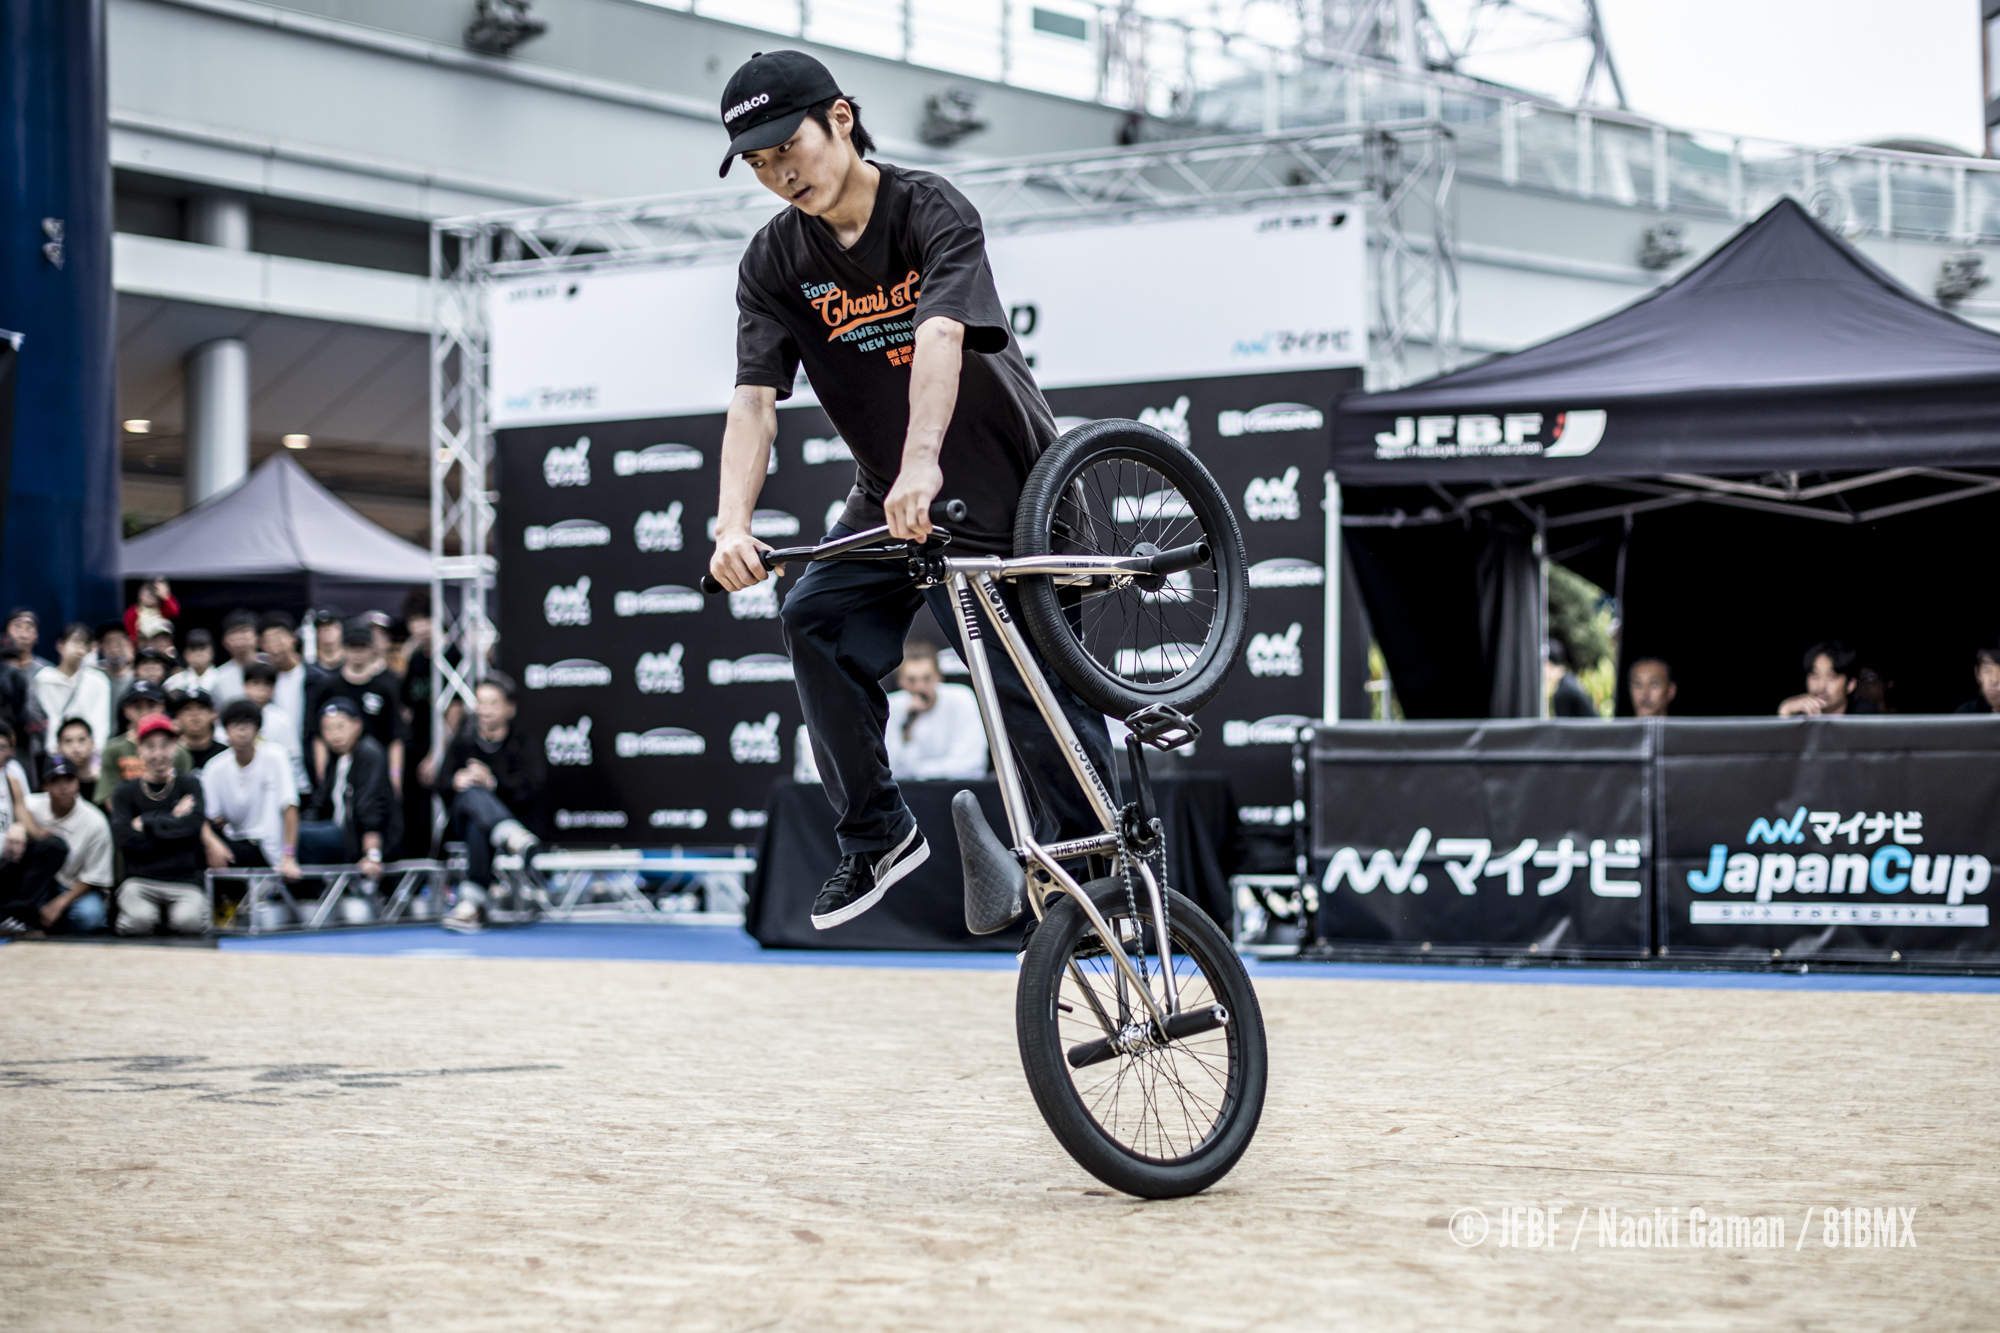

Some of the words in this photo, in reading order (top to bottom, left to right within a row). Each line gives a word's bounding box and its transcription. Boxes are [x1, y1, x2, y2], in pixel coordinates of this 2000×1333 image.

[811, 285, 888, 327] Chari
[840, 325, 883, 342] LOWER
[858, 336, 886, 352] NEW
[1375, 413, 1543, 449] JFBF
[1808, 811, 1924, 845] マイナビ
[1053, 844, 1074, 856] THE
[1075, 838, 1103, 853] PARK
[1436, 838, 1642, 898] マイナビ
[1687, 844, 1992, 905] JapanCup
